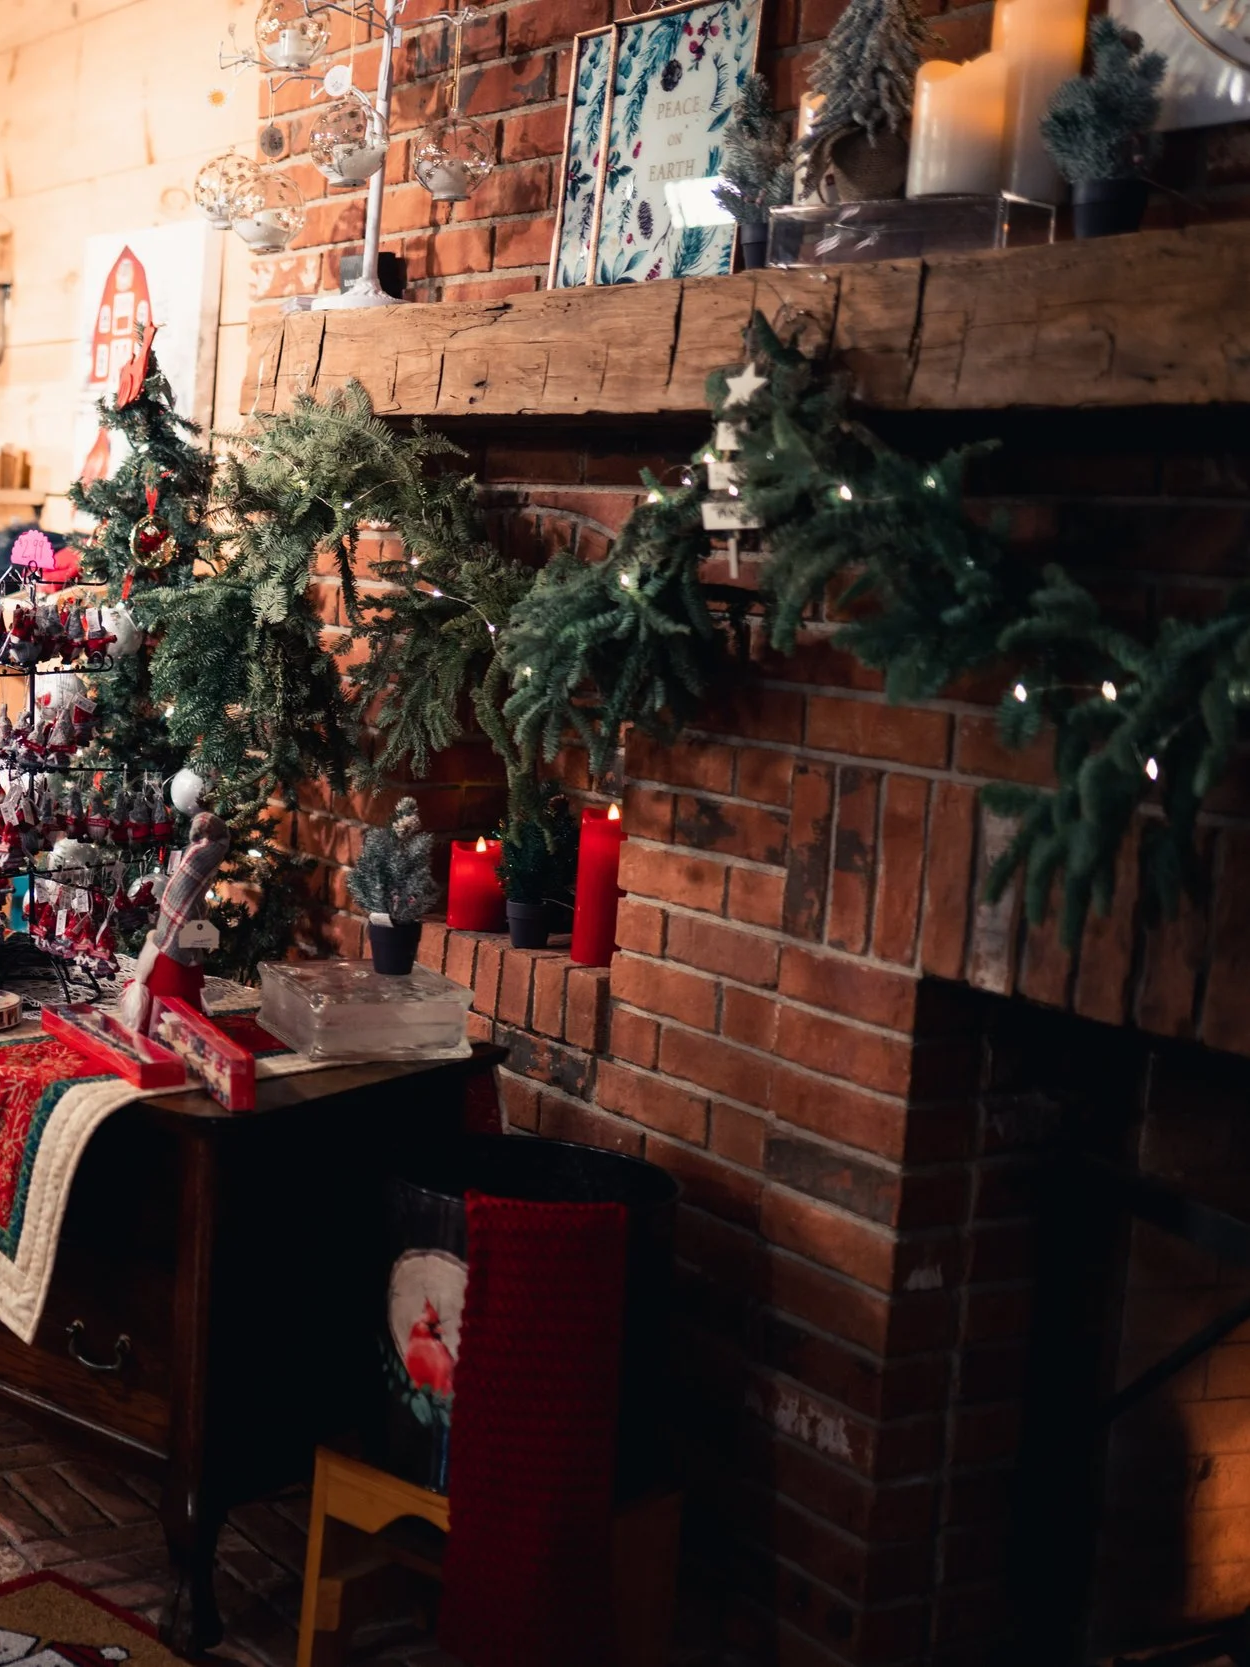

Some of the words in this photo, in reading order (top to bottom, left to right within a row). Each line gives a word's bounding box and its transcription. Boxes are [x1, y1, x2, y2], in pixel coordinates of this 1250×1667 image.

[656, 95, 701, 120] PEACE
[667, 132, 684, 147] ON
[648, 159, 696, 182] EARTH
